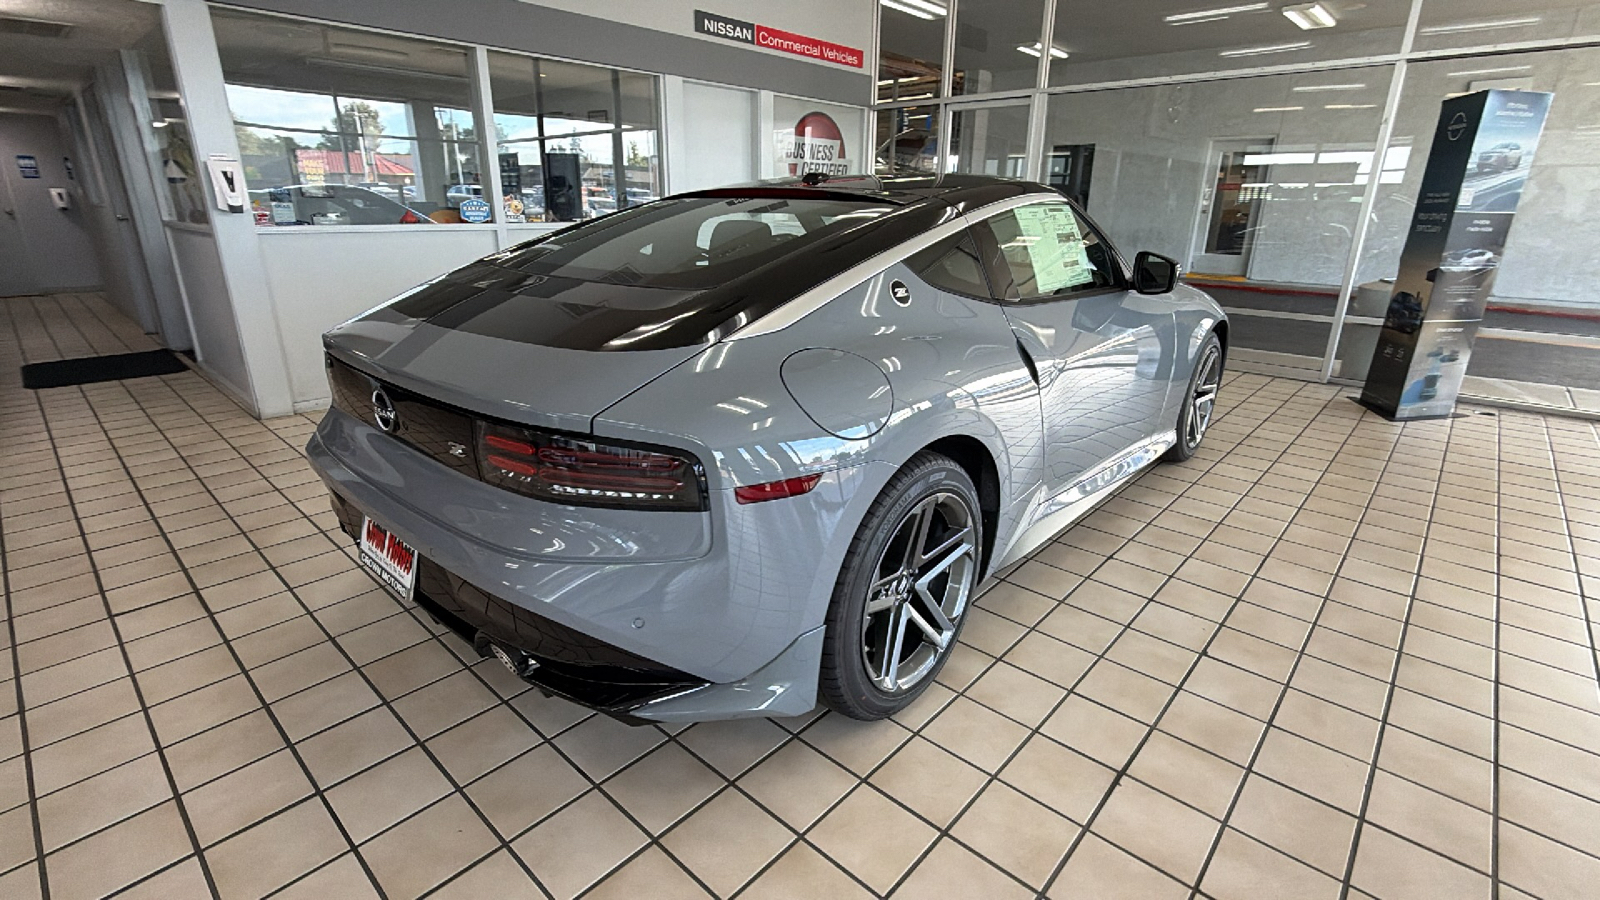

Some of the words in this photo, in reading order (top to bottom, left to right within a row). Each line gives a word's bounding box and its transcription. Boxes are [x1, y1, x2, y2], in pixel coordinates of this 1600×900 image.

[704, 18, 752, 40] NISSAN
[759, 31, 820, 56] Commercial
[822, 46, 858, 65] Vehicles
[361, 552, 382, 577] CROWN
[381, 570, 408, 598] MOTORS
